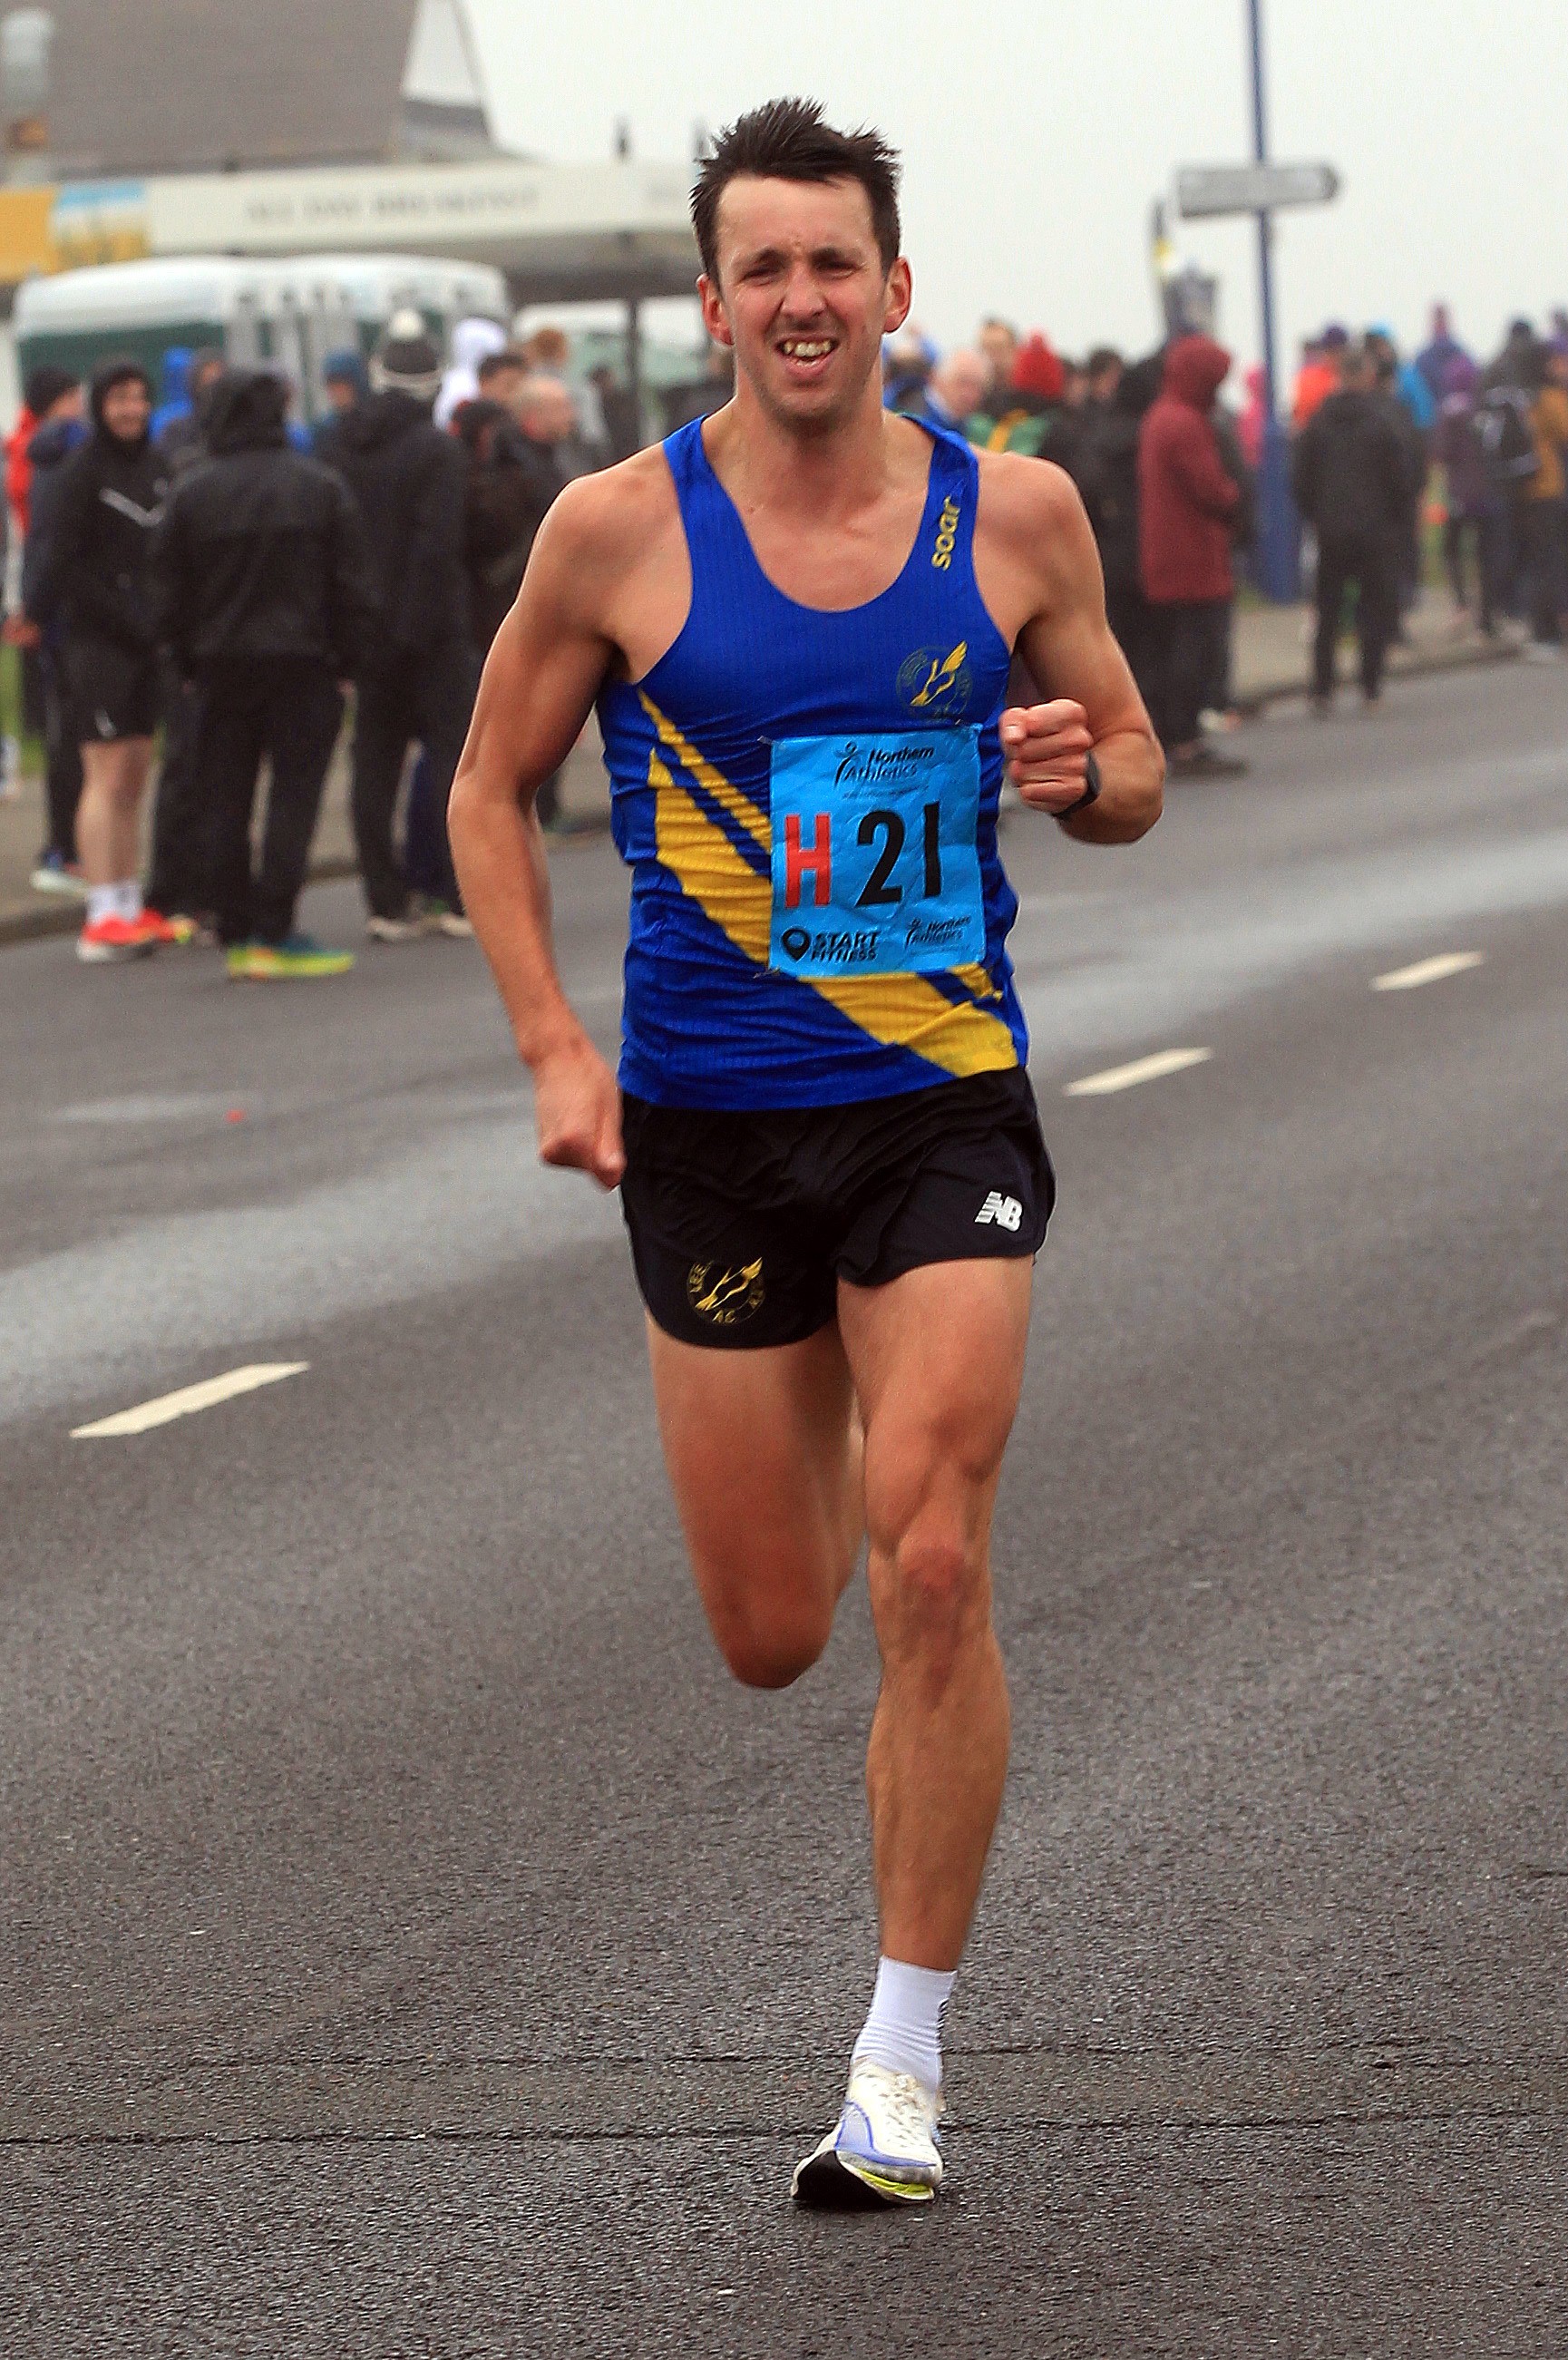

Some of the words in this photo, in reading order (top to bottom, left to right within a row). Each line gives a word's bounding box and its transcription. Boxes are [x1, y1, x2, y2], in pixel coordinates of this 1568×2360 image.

[869, 746, 934, 765] Northern
[785, 813, 832, 909] H
[856, 801, 942, 908] 21
[814, 930, 882, 950] START
[811, 947, 878, 962] FITNESS
